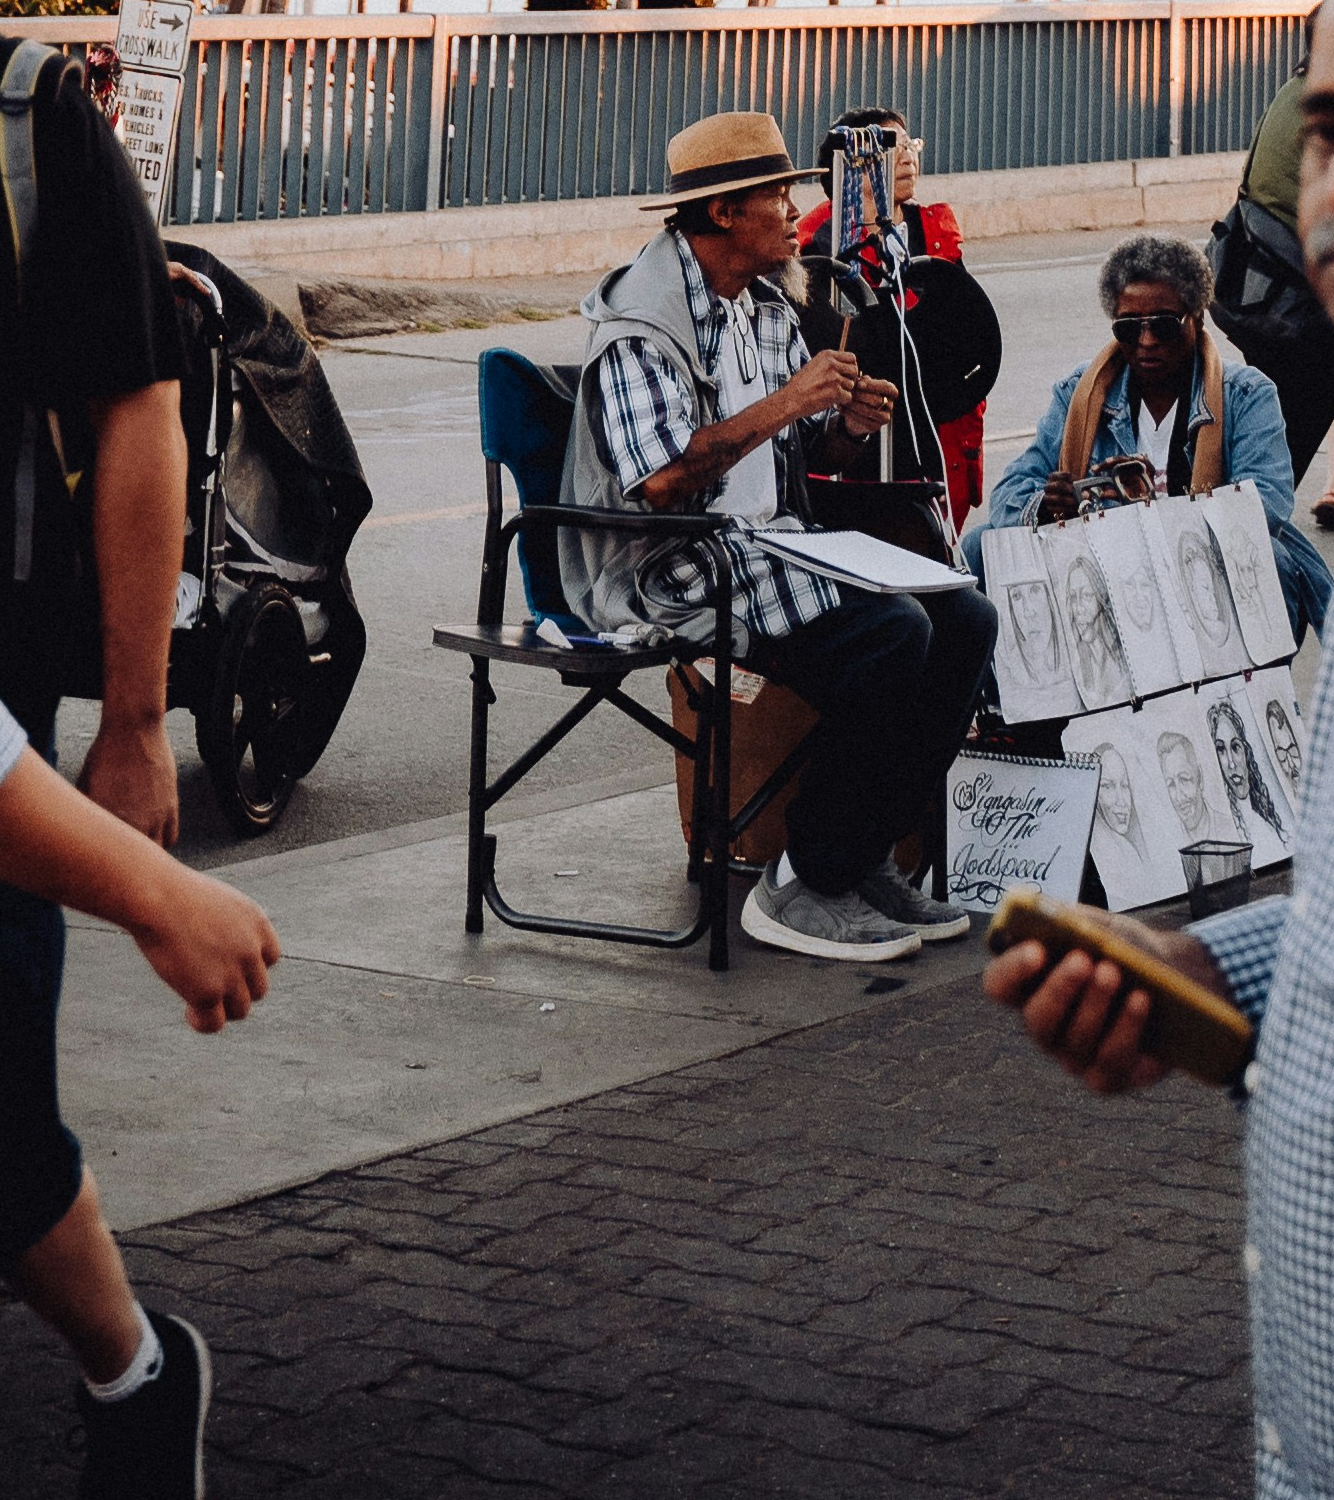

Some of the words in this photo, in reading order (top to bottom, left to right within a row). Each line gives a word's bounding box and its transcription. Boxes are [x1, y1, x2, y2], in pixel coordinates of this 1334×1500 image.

[137, 8, 159, 30] USE
[118, 33, 180, 61] CROSSWALK
[129, 103, 155, 119] HOMES
[144, 140, 165, 155] LONG
